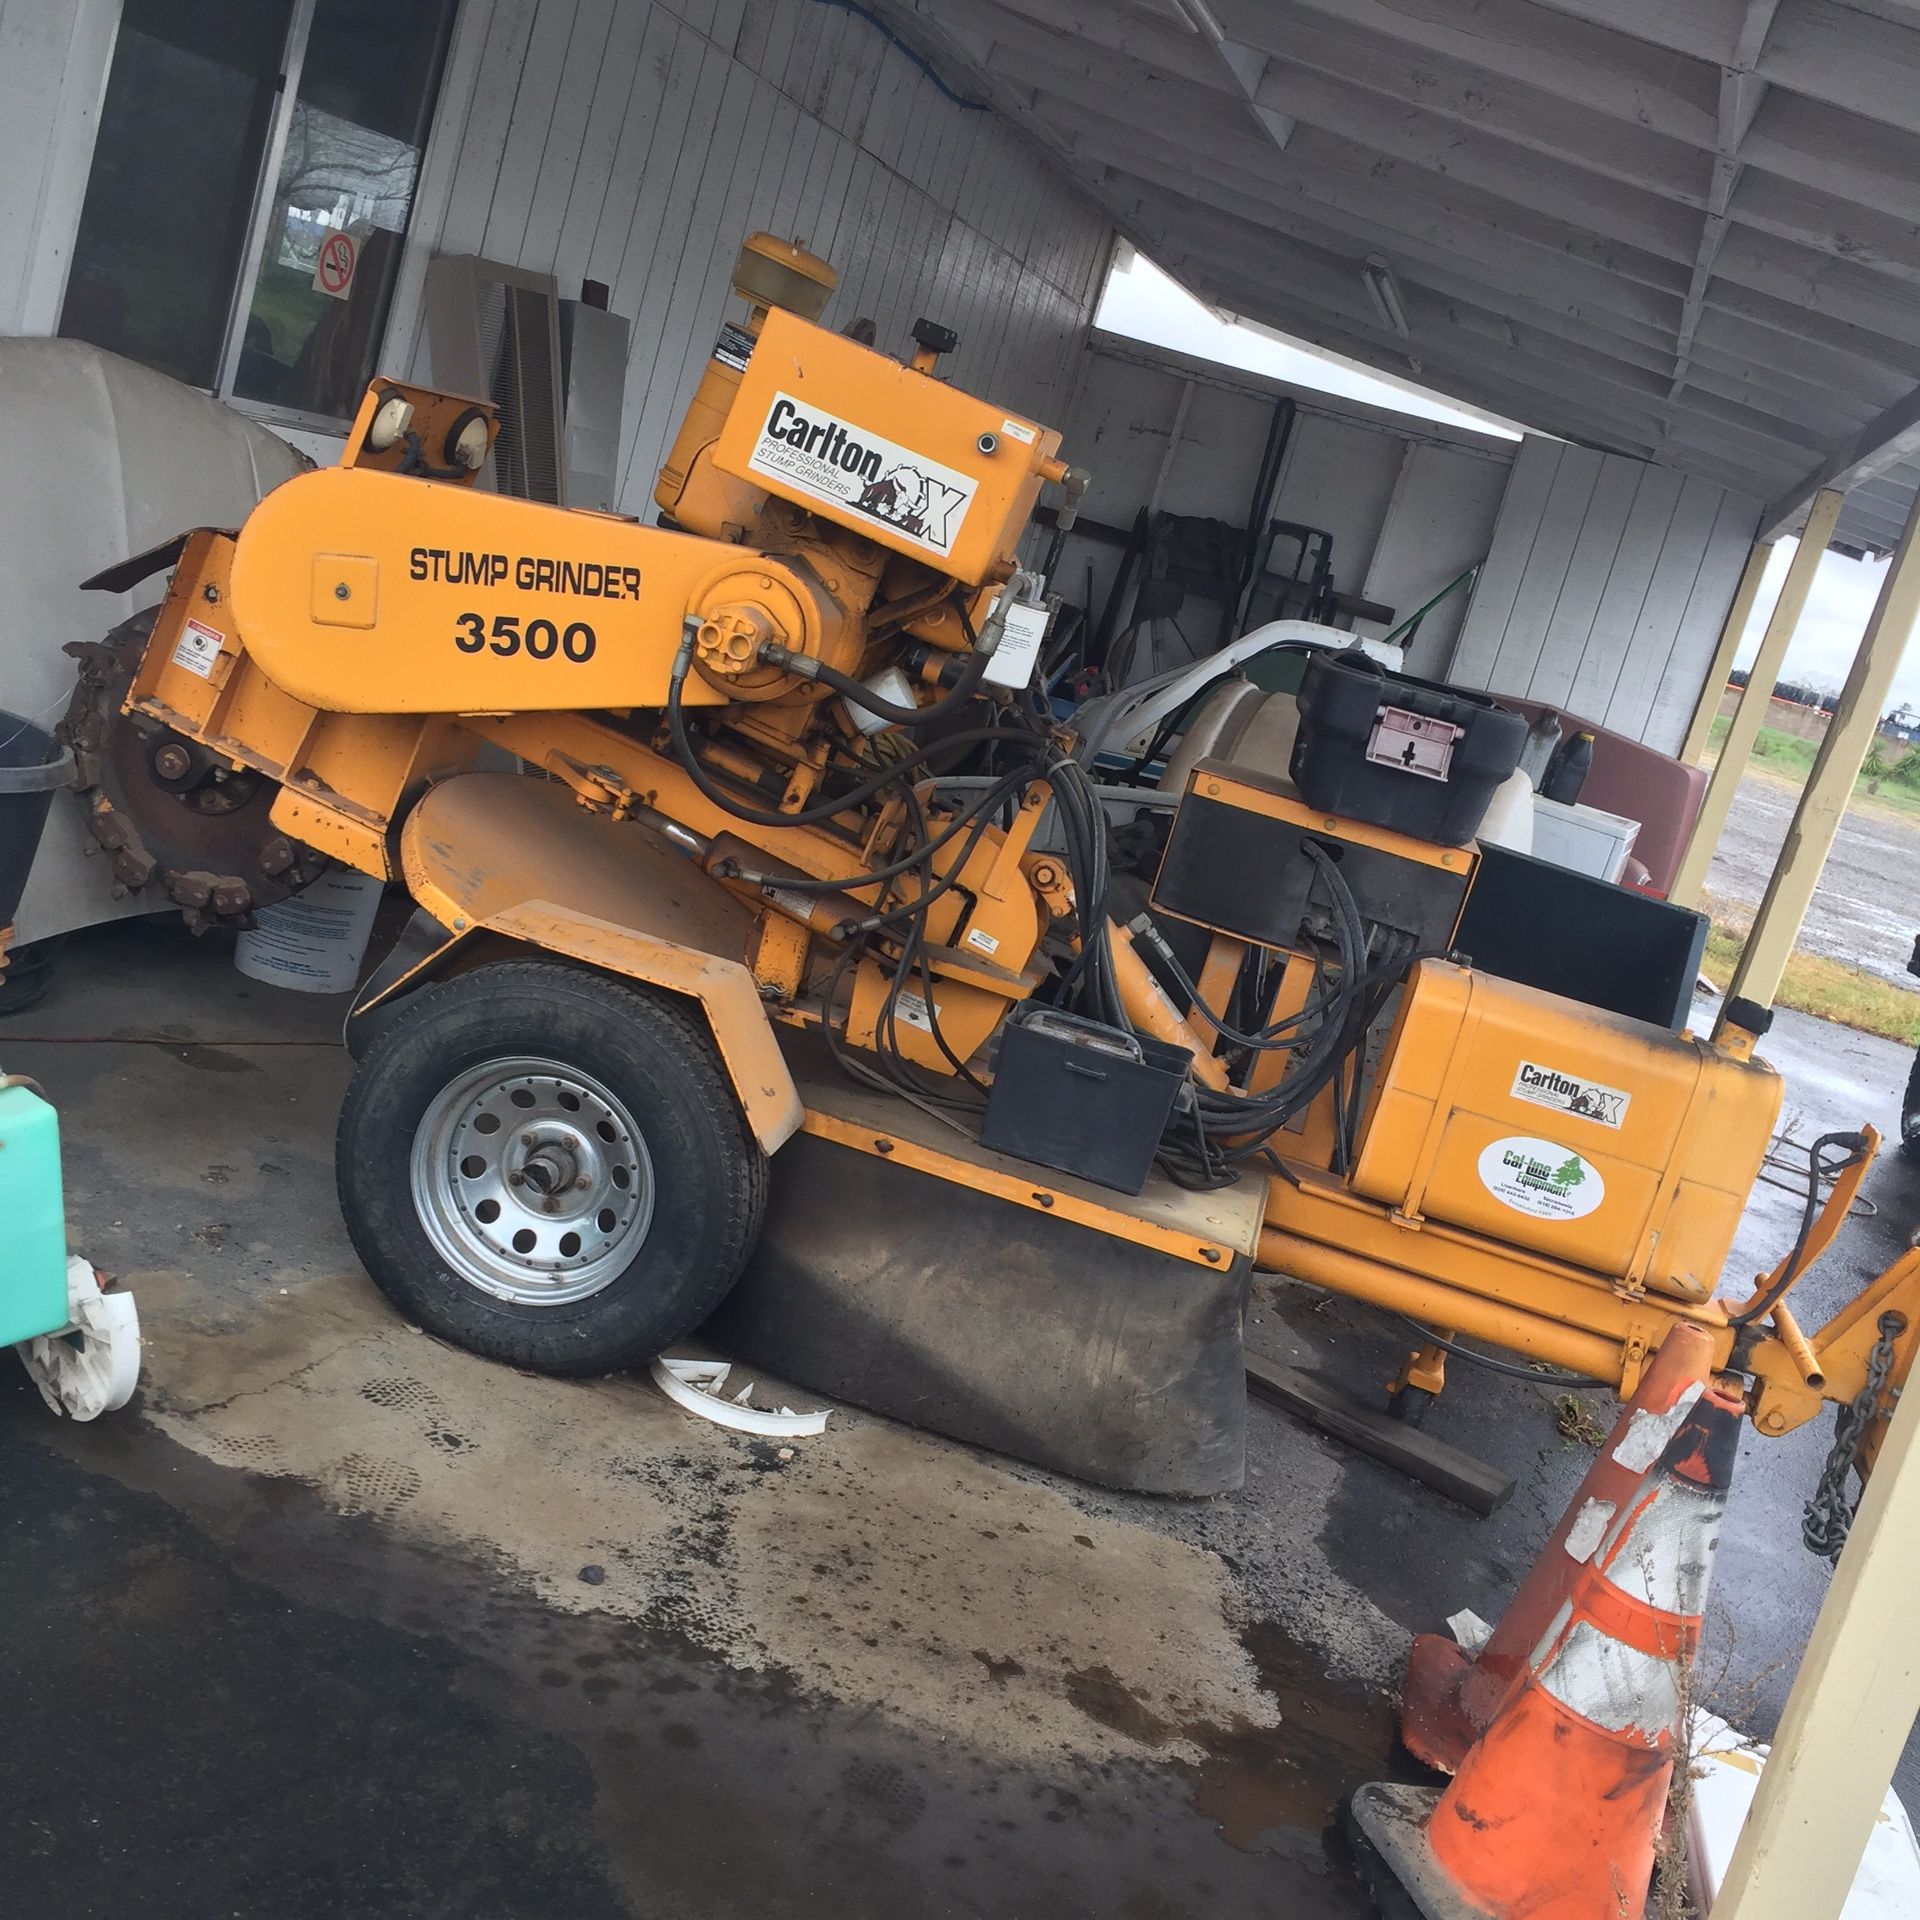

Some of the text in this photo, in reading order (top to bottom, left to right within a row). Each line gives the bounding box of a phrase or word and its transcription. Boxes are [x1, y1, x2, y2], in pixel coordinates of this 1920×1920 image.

[761, 437, 841, 479] PROFESSIONAL
[767, 399, 883, 483] Carlton
[757, 448, 796, 469] STUMP
[795, 464, 851, 496] GRINDERS
[410, 548, 641, 601] STUMP GRINDER
[455, 613, 597, 664] 3500
[1520, 1064, 1580, 1098] Carlton
[1515, 1171, 1569, 1198] Equipment
